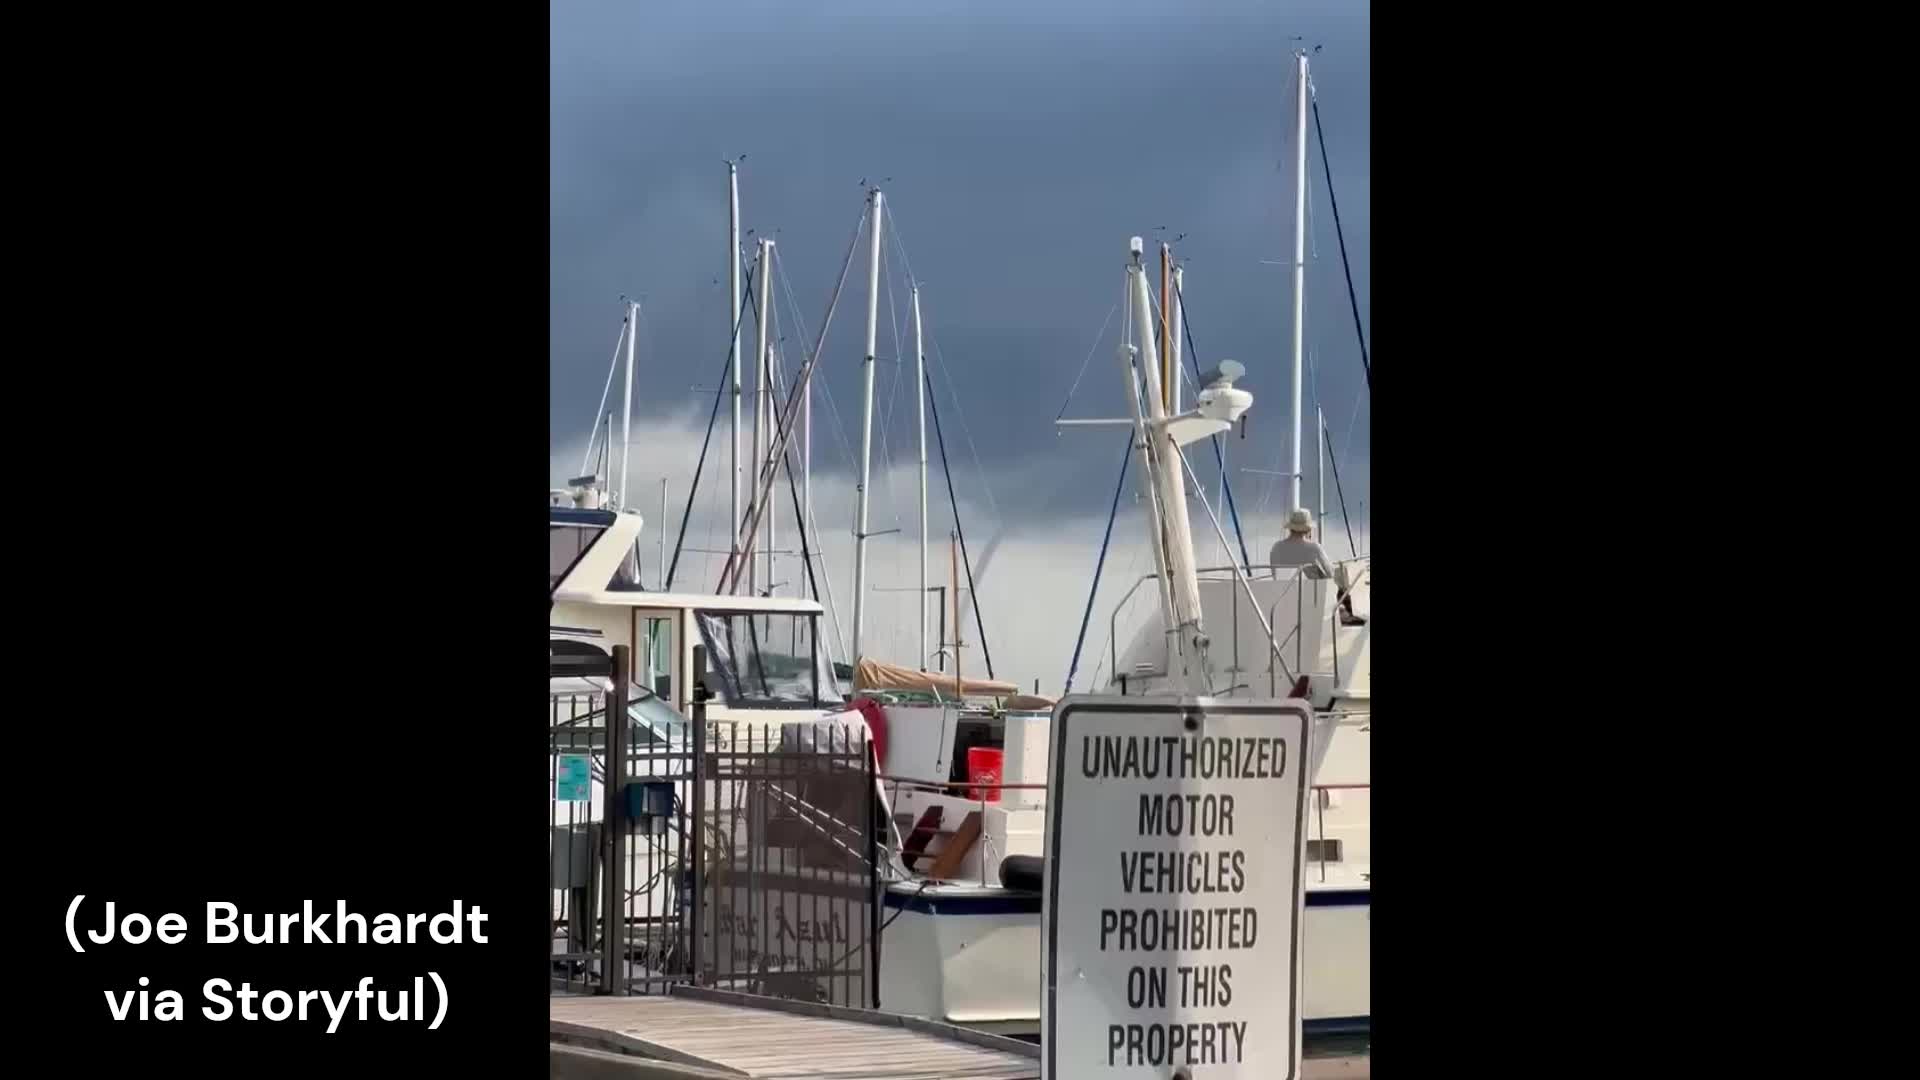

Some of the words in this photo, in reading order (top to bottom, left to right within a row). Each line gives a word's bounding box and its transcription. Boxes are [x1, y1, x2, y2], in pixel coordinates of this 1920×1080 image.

[1082, 736, 1287, 779] UNAUTHORIZED
[1138, 794, 1235, 836] MOTOR
[1120, 850, 1246, 894] VEHICLES
[1100, 907, 1258, 951] PROHIBITED
[1127, 966, 1167, 1008] ON
[1177, 964, 1233, 1008] THIS
[1107, 1021, 1248, 1067] PROPERTY
